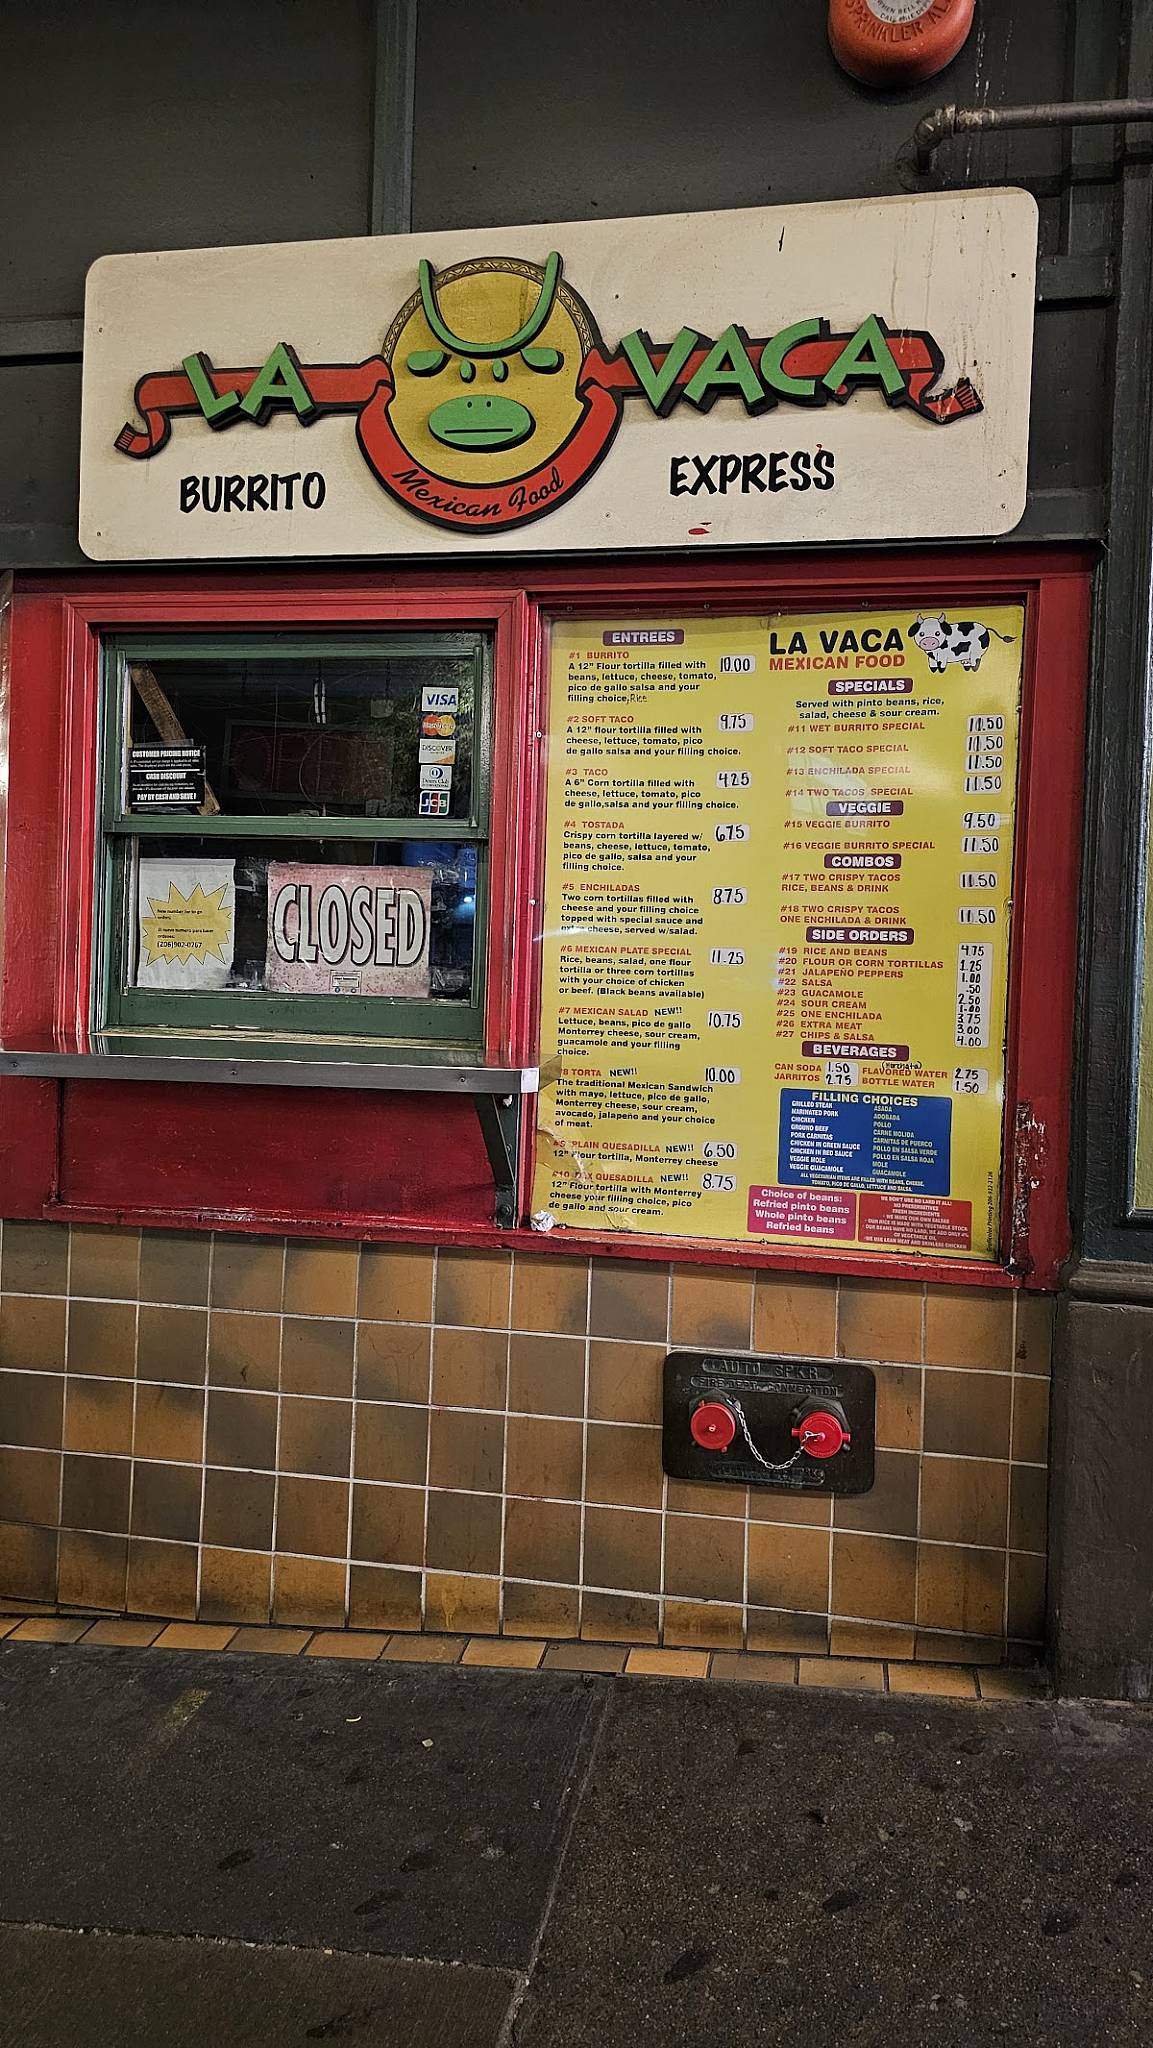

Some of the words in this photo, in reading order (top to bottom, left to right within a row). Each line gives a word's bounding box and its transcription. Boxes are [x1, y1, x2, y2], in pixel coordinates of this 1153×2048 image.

[621, 313, 905, 411] VACA
[182, 342, 315, 419] LA
[669, 450, 835, 497] EXPRESS
[180, 471, 326, 513] BURRITO
[392, 468, 502, 517] Mexican
[508, 465, 564, 512] Food
[612, 631, 675, 643] ENTREES
[769, 631, 807, 655] LA
[819, 628, 904, 654] VACA
[586, 651, 629, 659] BURRITO
[568, 662, 575, 670] A
[597, 662, 621, 670] Flour
[623, 662, 655, 670] tortilla
[658, 661, 682, 669] filled
[685, 661, 706, 669] with
[720, 657, 751, 673] 10.00
[769, 656, 849, 671] MEXICAN
[855, 654, 905, 669] FOOD
[568, 673, 599, 682] beans,
[602, 673, 638, 681] lettuce,
[640, 672, 676, 681] cheese,
[678, 672, 717, 681] tomato,
[568, 684, 588, 693] pico
[604, 683, 627, 693] gallo
[630, 683, 655, 691] salsa
[658, 683, 676, 691] and
[678, 683, 700, 692] your
[835, 680, 905, 692] SPECIALS
[427, 694, 457, 705] VISA
[567, 694, 594, 703] filling
[795, 700, 829, 709] Served
[832, 699, 854, 708] with
[857, 698, 883, 709] pinto
[886, 698, 920, 708] beans,
[922, 697, 945, 706] rice,
[799, 710, 829, 720] salad,
[832, 710, 866, 719] cheese
[869, 710, 877, 718] &
[879, 709, 902, 718] sour
[905, 708, 940, 717] cream.
[788, 725, 806, 733] #11
[809, 724, 831, 732] WET
[834, 723, 879, 732] BURRITO
[882, 722, 925, 731] SPECIAL
[583, 768, 608, 776] TACO
[421, 798, 447, 807] JCB
[839, 803, 891, 813] VEGGIE
[564, 821, 576, 829] #4
[582, 821, 625, 829] TOSTADA
[805, 820, 842, 829] VEGGIE
[844, 819, 890, 828] BURRITO
[963, 813, 995, 829] 9.50
[831, 856, 894, 867] COMBOS
[869, 874, 901, 882] TACOS
[562, 883, 575, 891] #5
[580, 884, 640, 892] ENCHILADAS
[781, 884, 808, 893] RICE,
[810, 884, 844, 892] BEANS
[847, 884, 854, 892] &
[857, 884, 889, 892] DRINK
[272, 883, 427, 967] CLOSED
[812, 929, 845, 940] SIDE
[848, 930, 908, 942] ORDERS
[560, 945, 573, 953] #6
[575, 945, 618, 954] MEXICAN
[620, 946, 649, 955] PLATE
[651, 947, 692, 956] SPECIAL
[803, 947, 827, 955] RICE
[853, 948, 888, 956] BEANS
[857, 970, 904, 978] PEPPERS
[573, 1007, 616, 1016] MEXICAN
[618, 1008, 648, 1017] SALAD
[708, 1012, 741, 1029] 10.75
[800, 1031, 831, 1039] CHIPS
[833, 1032, 841, 1040] &
[844, 1033, 875, 1041] SALSA
[813, 1044, 897, 1058] BEVERAGES
[571, 1069, 602, 1077] TORTA
[774, 1063, 793, 1071] CAN
[796, 1064, 822, 1072] SODA
[705, 1067, 735, 1083] 10.00
[774, 1073, 820, 1082] JARRITOS
[862, 1077, 899, 1087] BOTTLE
[902, 1079, 935, 1088] WATER
[811, 1091, 859, 1103] FILLING
[862, 1094, 918, 1106] CHOICES
[556, 1099, 602, 1110] Monterrey
[605, 1101, 640, 1111] cheese,
[642, 1103, 663, 1112] sour
[665, 1104, 698, 1114] cream,
[602, 1142, 660, 1153] QUESADILLA
[595, 1172, 654, 1184] QUESADILLA
[702, 1173, 734, 1191] 8.75
[761, 1189, 794, 1199] Choice
[797, 1191, 808, 1200] of
[810, 1192, 842, 1203] beans:
[753, 1199, 788, 1210] Refried
[791, 1202, 815, 1213] pinto
[818, 1204, 850, 1214] beans
[755, 1210, 785, 1220] Whole
[787, 1212, 813, 1223] pinto
[815, 1215, 847, 1225] beans
[719, 1360, 761, 1376] AUTO
